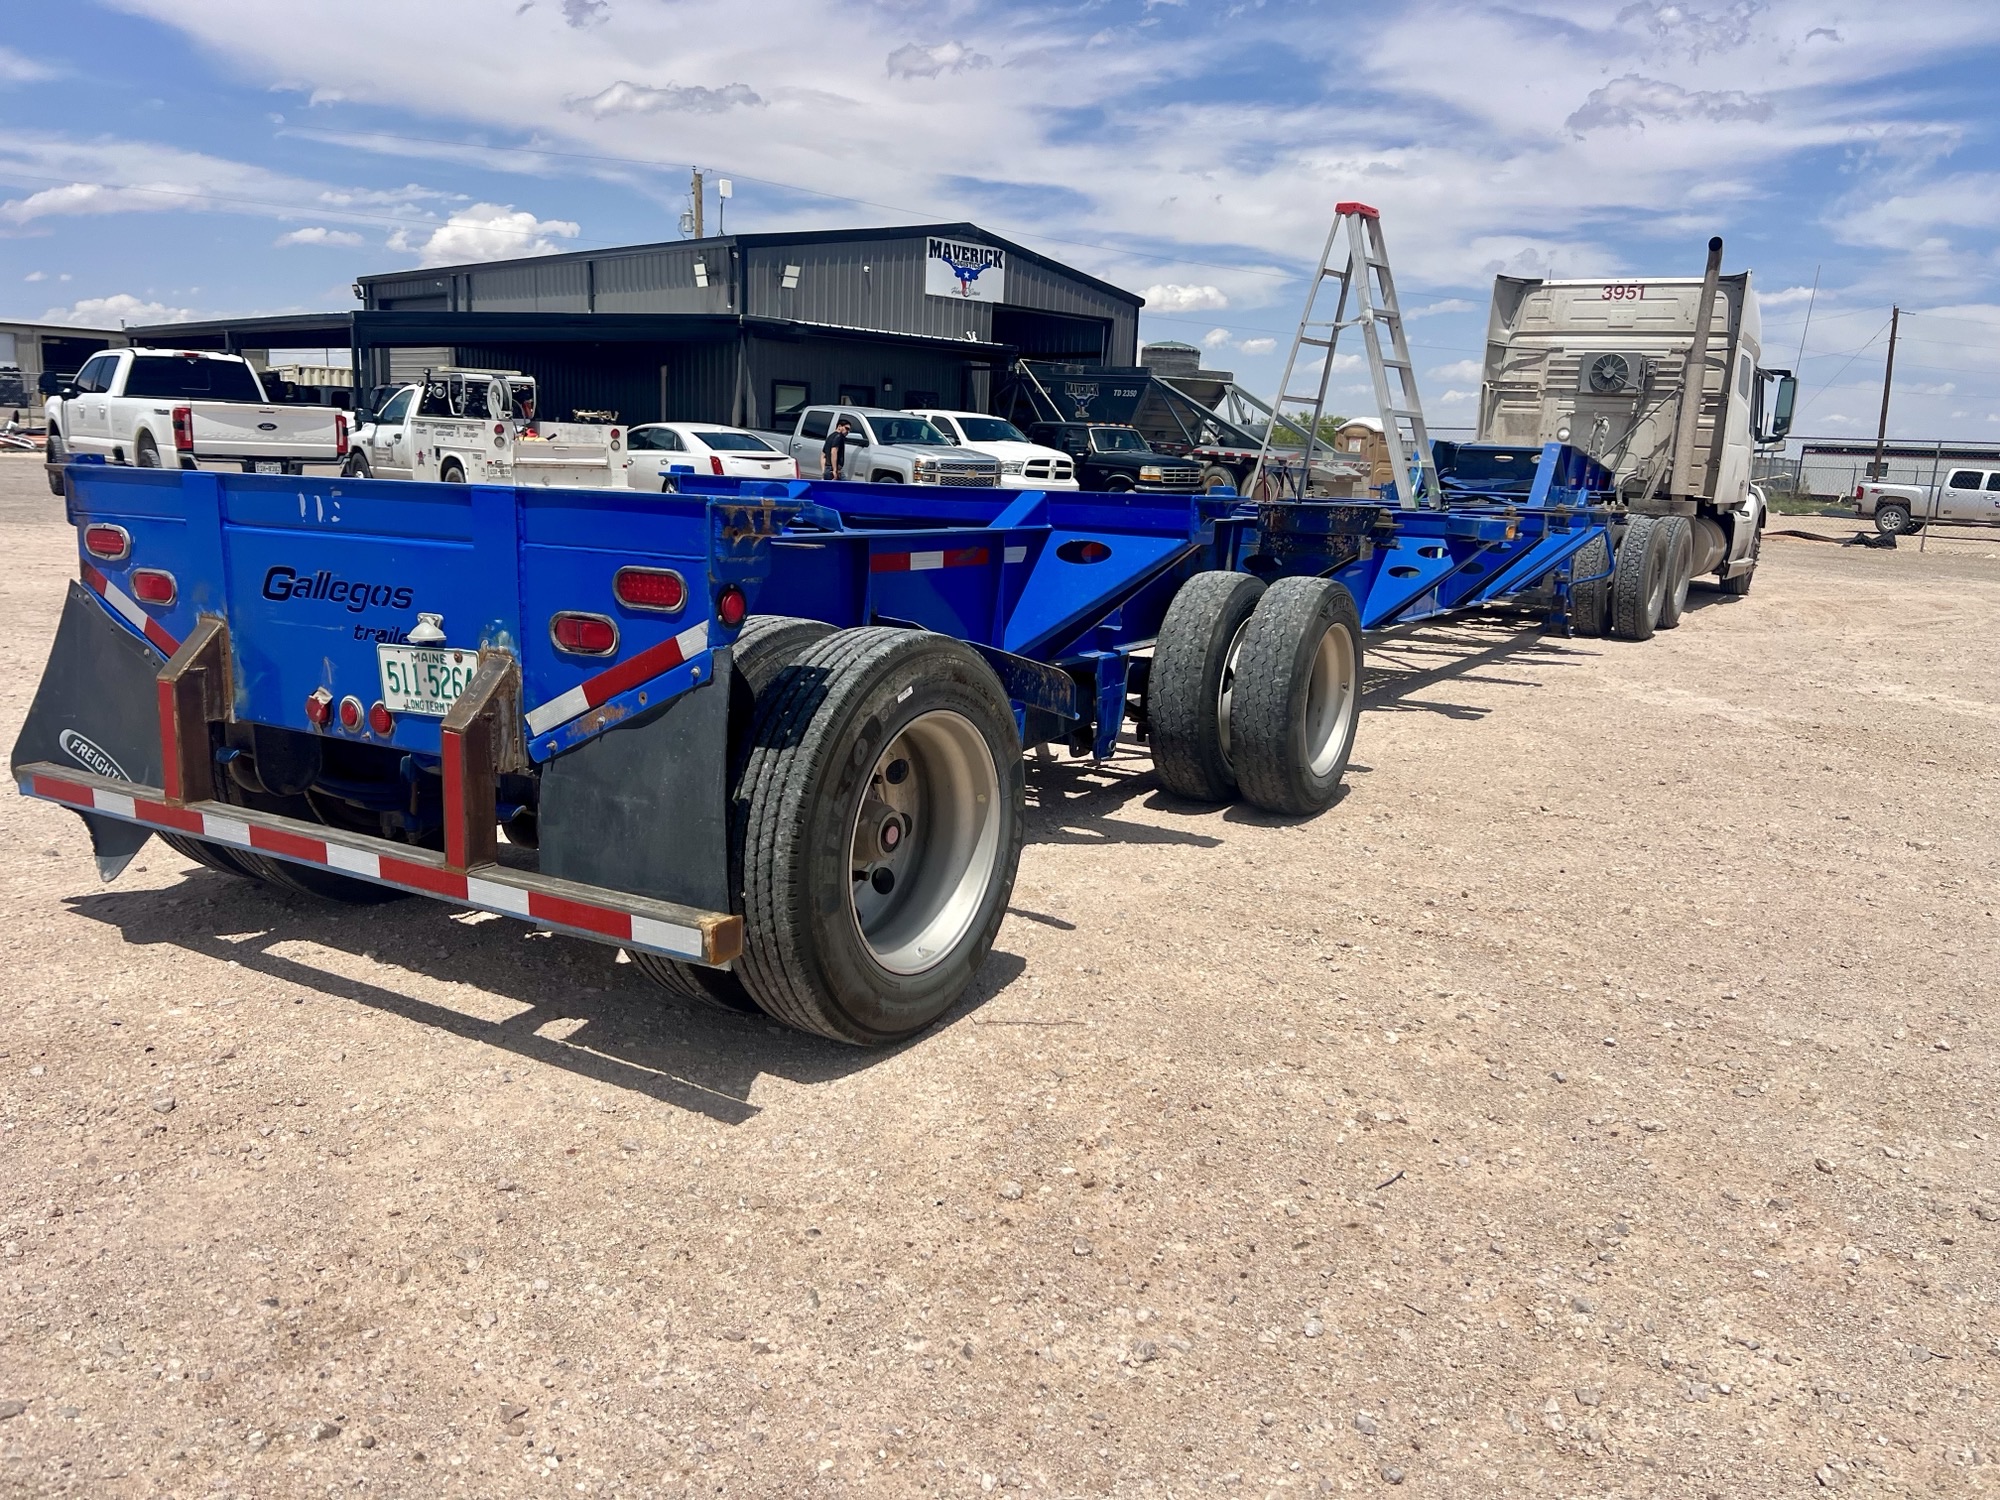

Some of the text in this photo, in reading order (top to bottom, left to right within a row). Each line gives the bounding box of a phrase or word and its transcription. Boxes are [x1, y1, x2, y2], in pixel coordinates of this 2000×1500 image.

[928, 239, 1003, 269] MAVERICK
[952, 259, 981, 269] LOGISTICS
[1601, 285, 1645, 300] 3951
[1065, 382, 1099, 396] MAVERICK
[1113, 389, 1138, 398] TD 2350
[262, 566, 415, 613] Gallegos
[353, 624, 410, 645] traile
[410, 652, 447, 664] MAINE
[405, 699, 424, 711] LONG
[425, 700, 446, 713] TERM
[69, 739, 121, 781] FREIGHT
